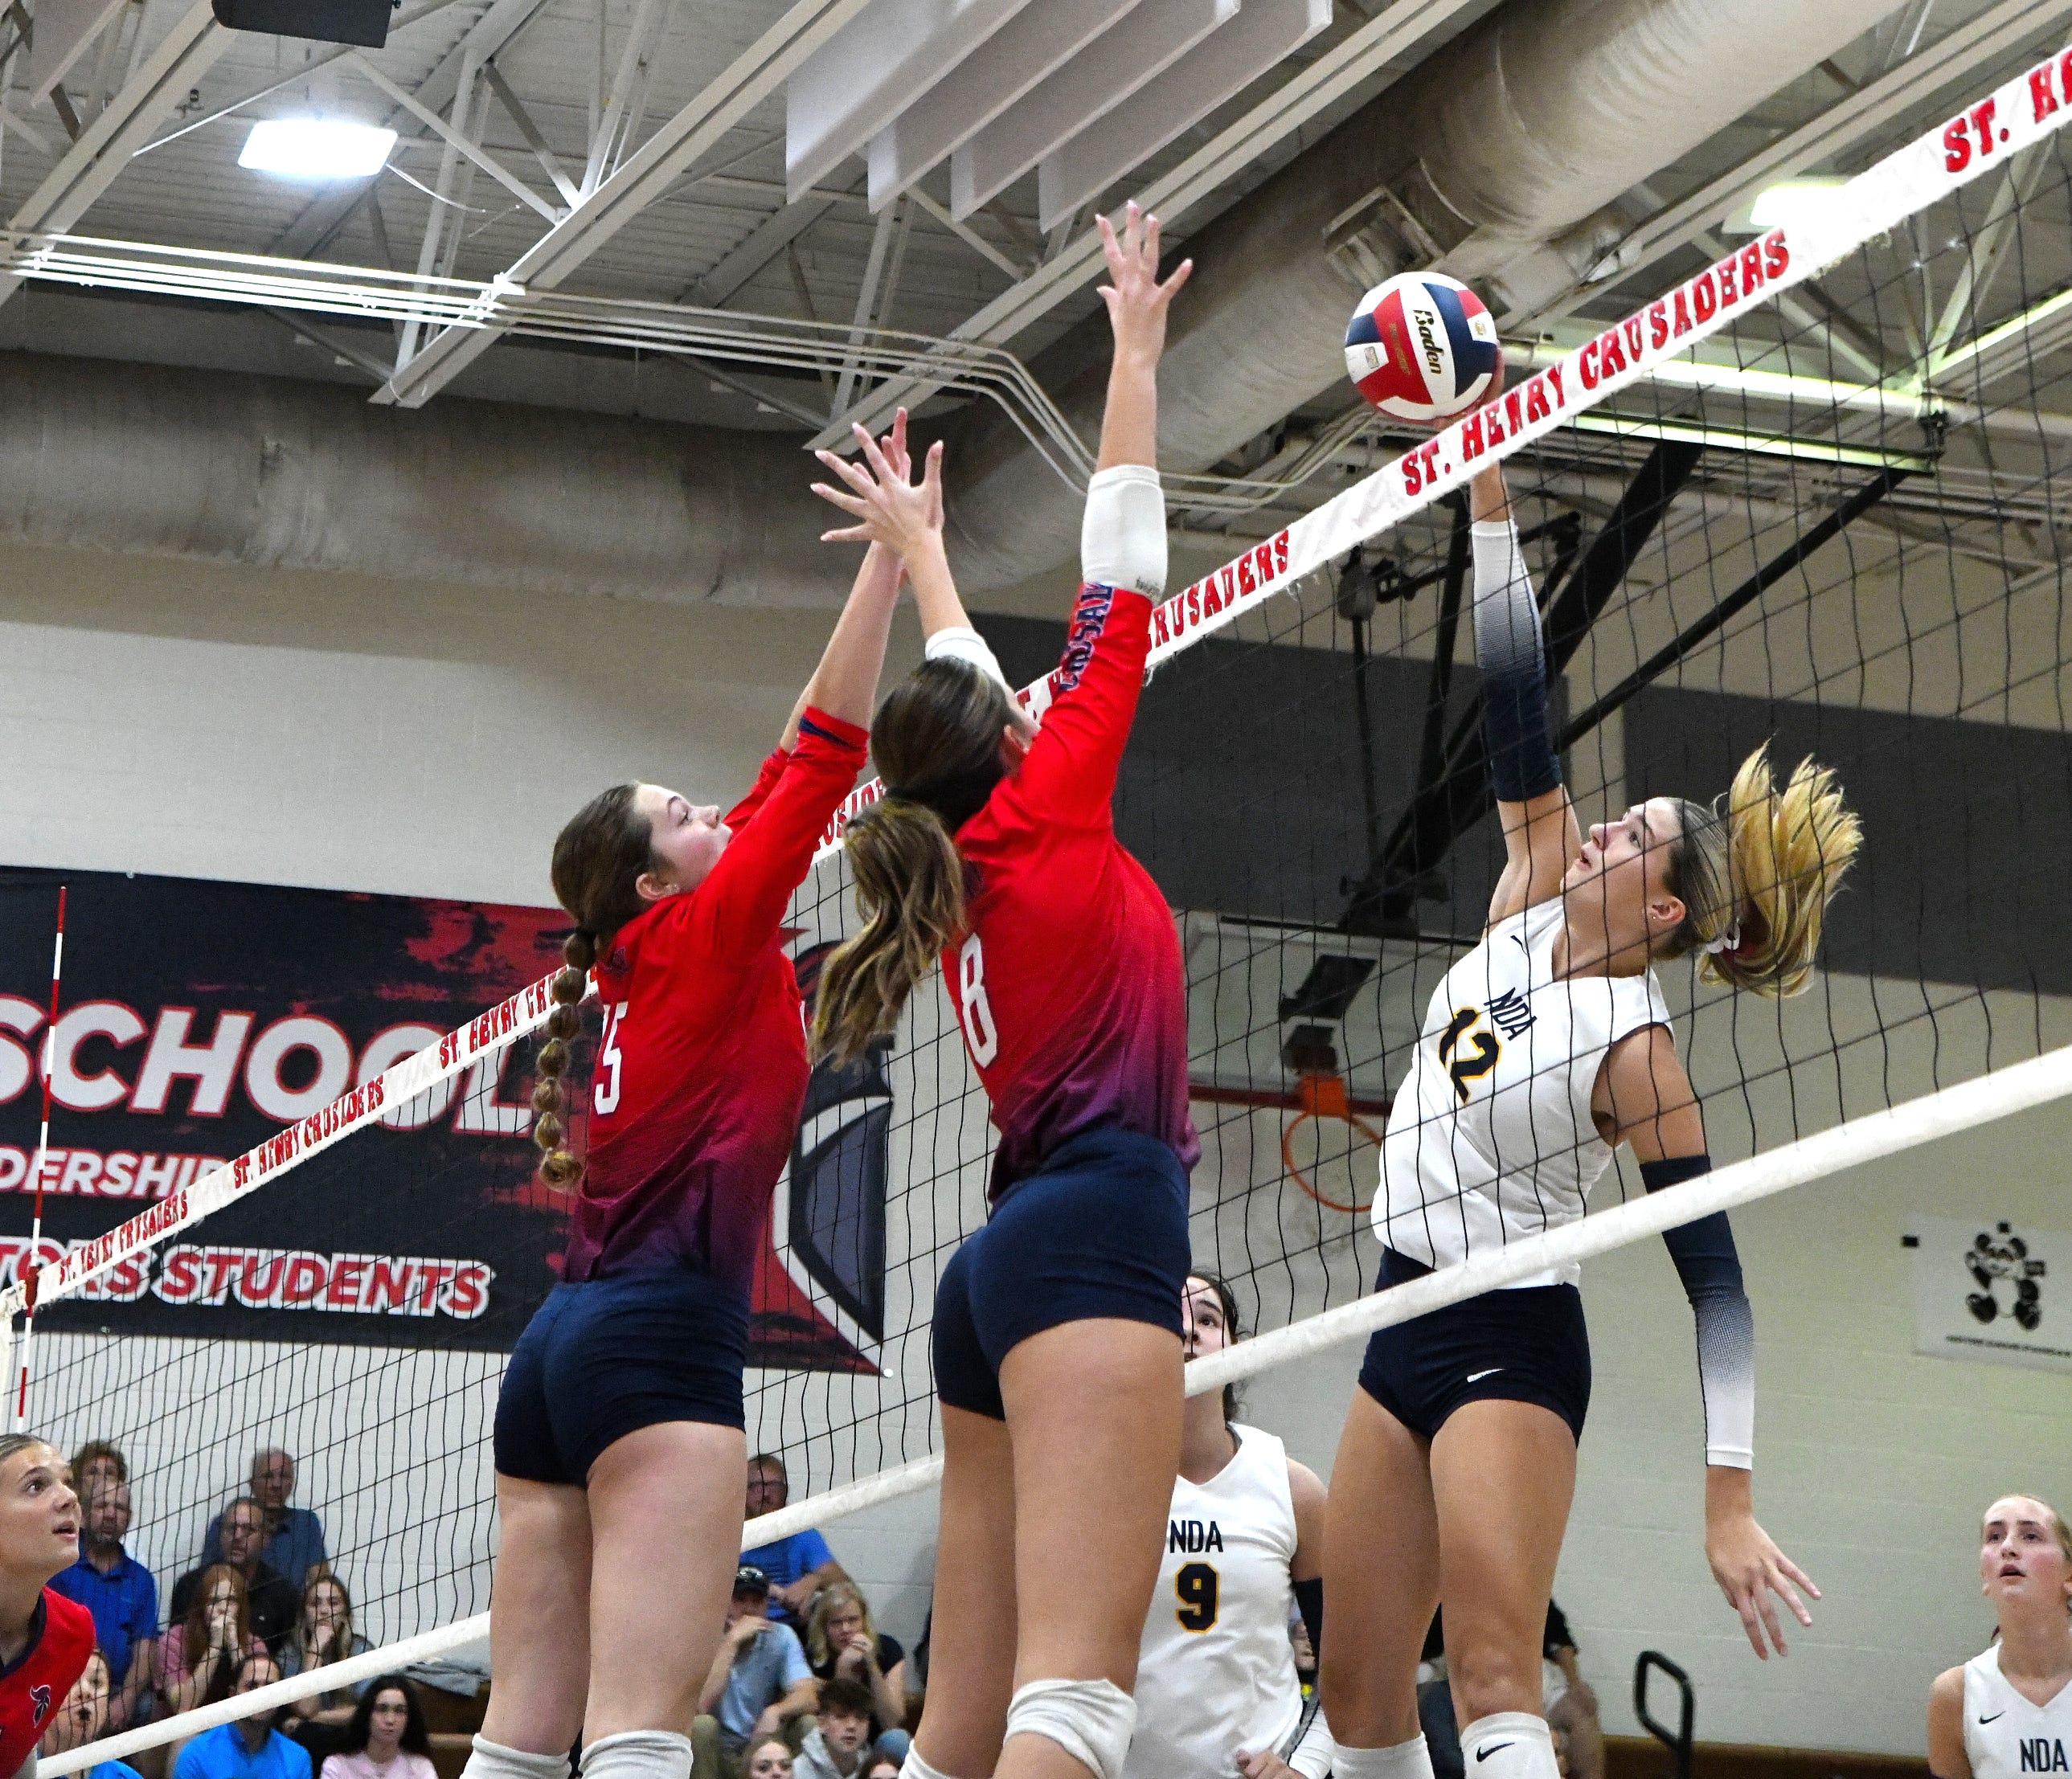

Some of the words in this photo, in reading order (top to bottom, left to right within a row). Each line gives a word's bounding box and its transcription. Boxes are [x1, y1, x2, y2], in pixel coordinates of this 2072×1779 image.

[1943, 97, 2010, 172] ST.
[1402, 440, 1451, 496] ST.
[1461, 360, 1566, 463] HENRY
[1579, 227, 1789, 390] CRUSADERS
[1413, 309, 1445, 374] Baden
[1148, 530, 1289, 653] RUSADERS
[960, 932, 998, 1069] 8
[1483, 987, 1537, 1041] NDA
[0, 994, 534, 1138] SCHOOL
[1438, 1005, 1502, 1106] 12
[157, 1247, 495, 1316] STUDENTS
[1169, 1519, 1224, 1554] NDA
[1175, 1560, 1220, 1634] 9
[2019, 1738, 2070, 1773] NDA
